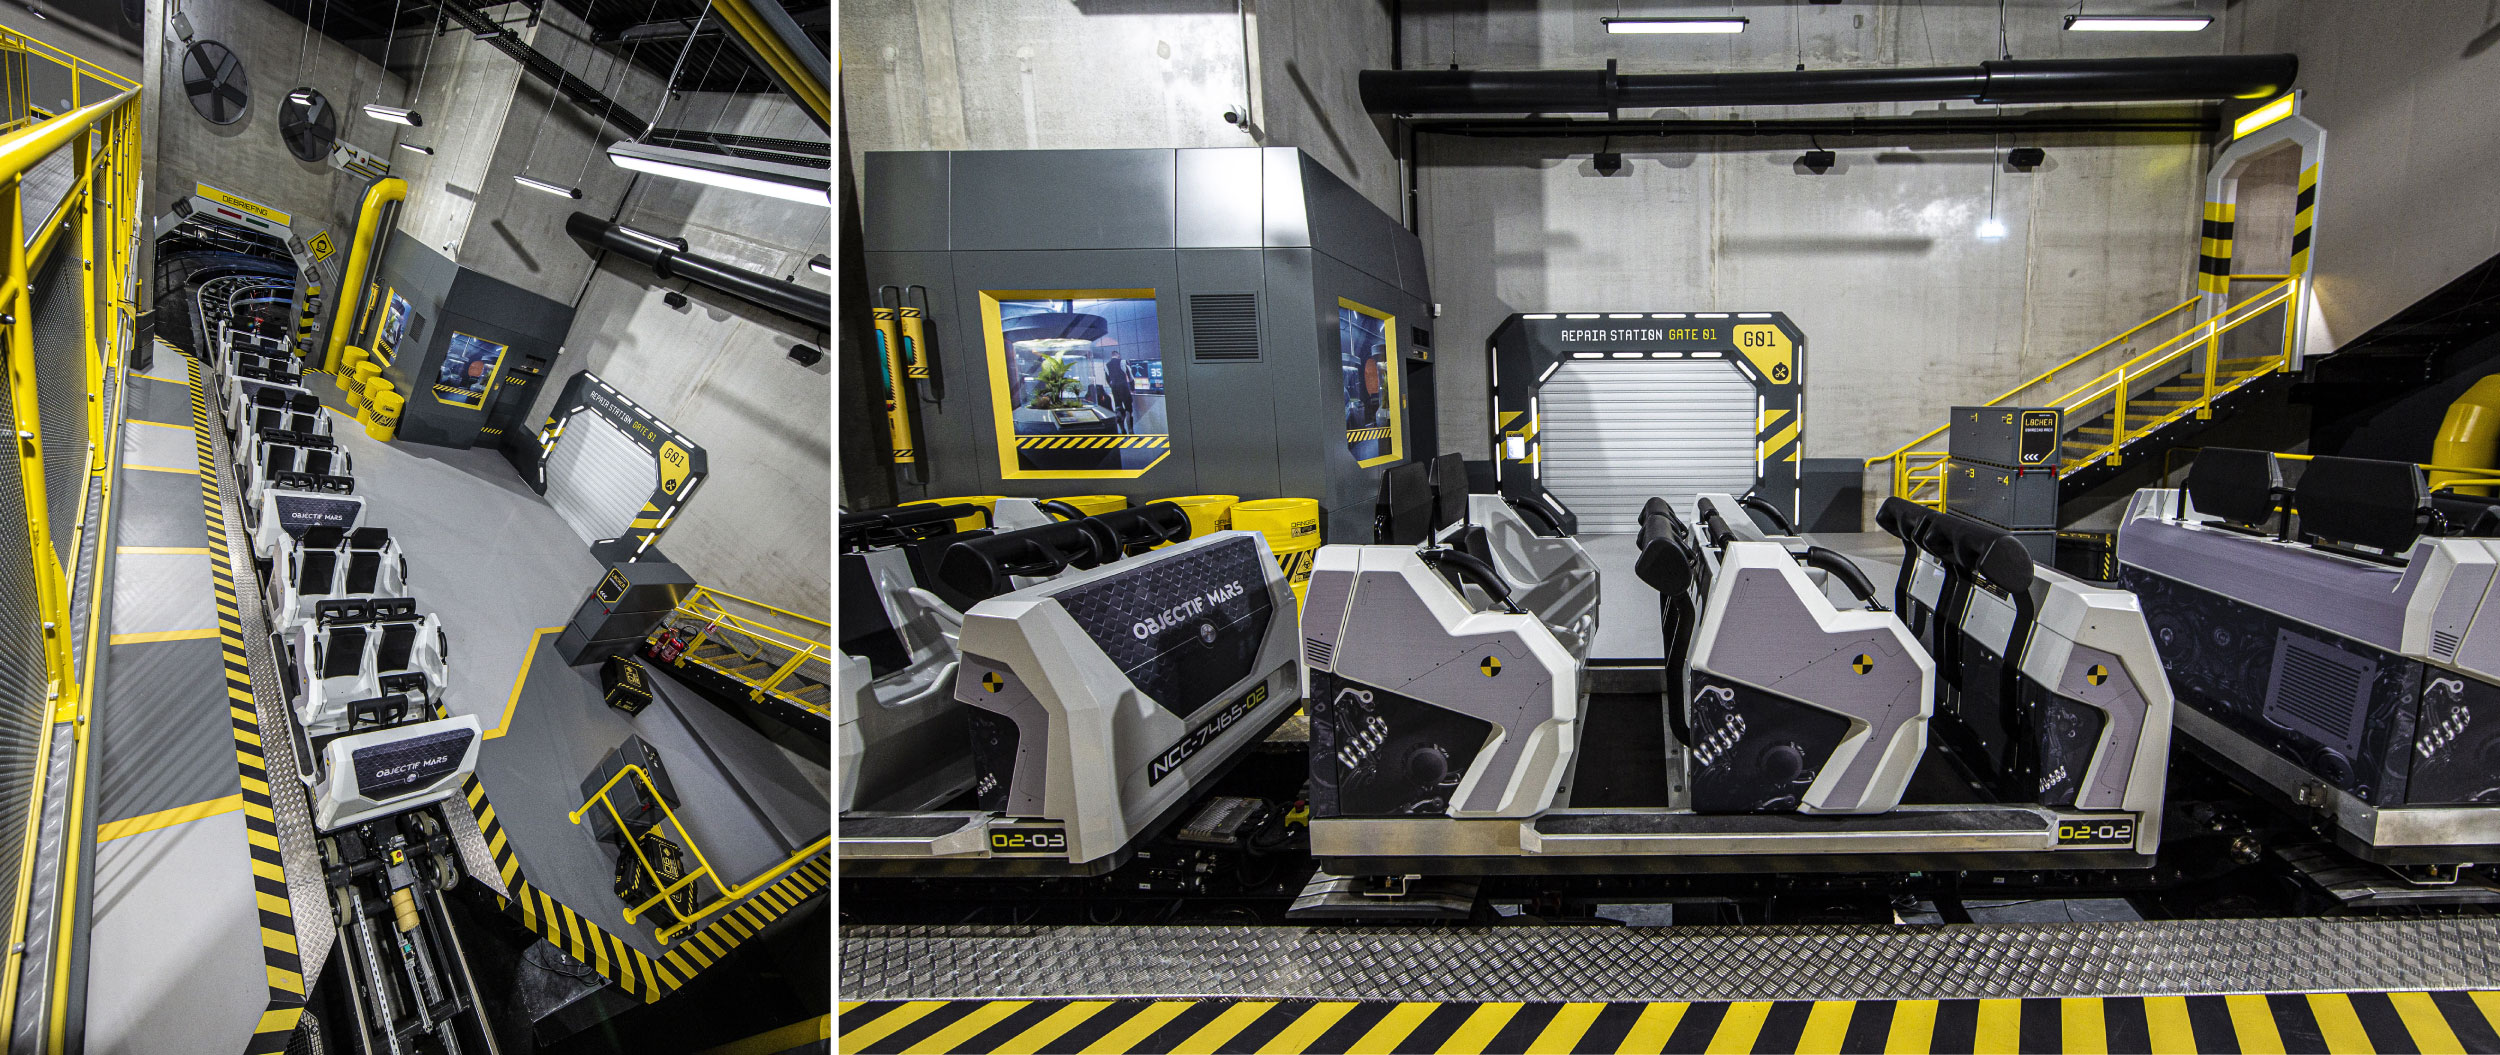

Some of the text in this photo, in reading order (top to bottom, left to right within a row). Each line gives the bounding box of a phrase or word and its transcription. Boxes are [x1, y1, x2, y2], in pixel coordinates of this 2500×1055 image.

[222, 194, 268, 216] DEBRIEFING
[1561, 328, 1717, 342] REPAIR STATION GATE 01
[1743, 331, 1776, 347] G01
[590, 390, 657, 443] REPAIR STATION GATE 01
[2006, 413, 2013, 425] 2
[663, 447, 685, 468] G01
[1969, 468, 2009, 486] 3 4
[291, 512, 323, 520] OBJECTIF
[1291, 519, 1316, 528] DANGER
[1133, 580, 1244, 640] OBJECTIF MARS
[1153, 685, 1266, 780] NCC-7465-02
[376, 755, 448, 778] OBJECTIF MARS
[2058, 825, 2131, 839] 02-02
[991, 834, 1065, 848] 02-03
